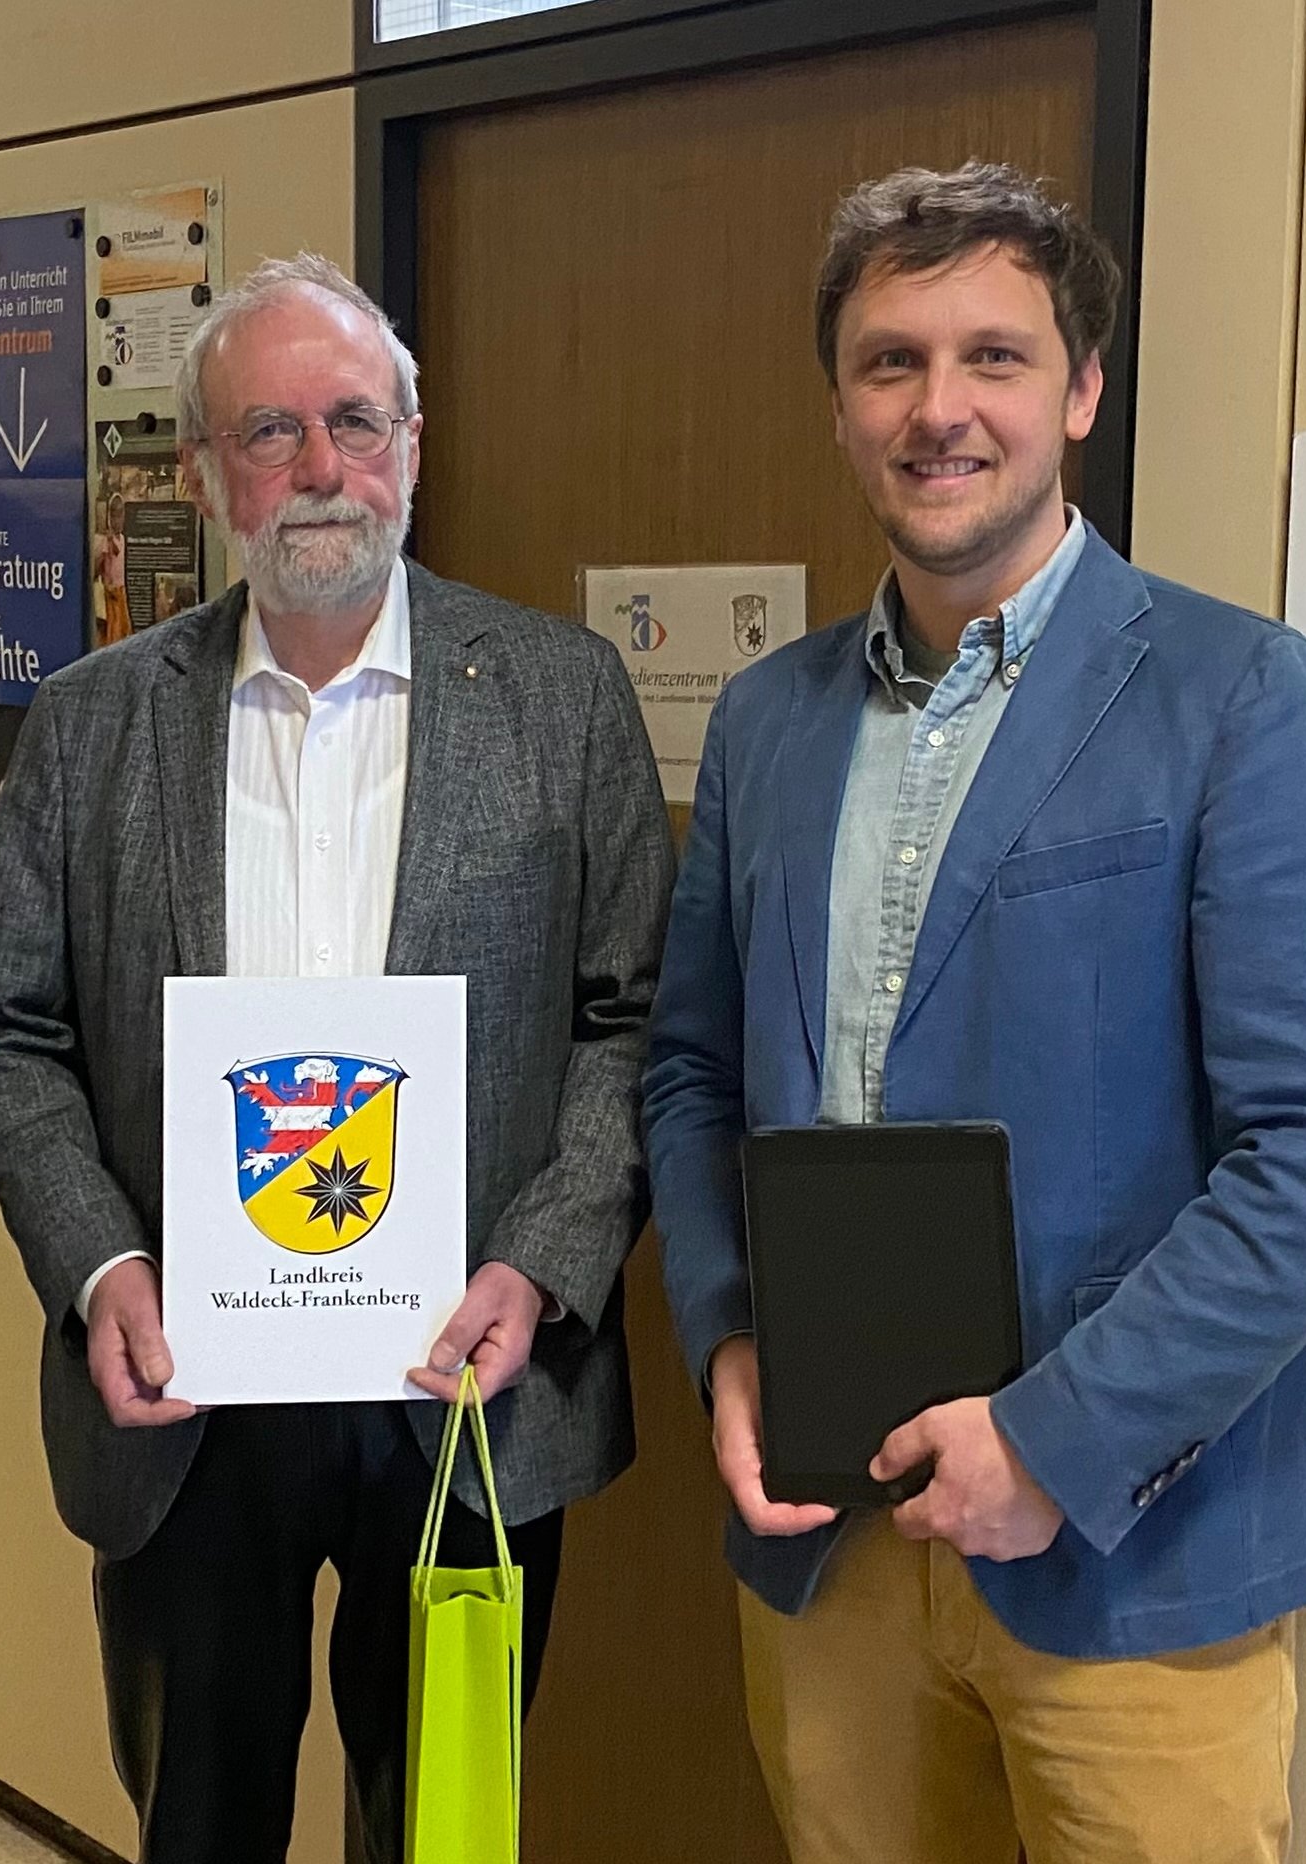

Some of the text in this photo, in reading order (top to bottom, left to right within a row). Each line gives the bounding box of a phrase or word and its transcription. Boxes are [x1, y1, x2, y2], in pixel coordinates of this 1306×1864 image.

[11, 265, 68, 290] Unterricht
[17, 297, 28, 316] in
[31, 295, 64, 315] Ihrem
[629, 666, 719, 688] edienzentrum
[269, 1266, 363, 1285] Landkreis
[211, 1289, 421, 1310] Waldeck-Frankenberg
